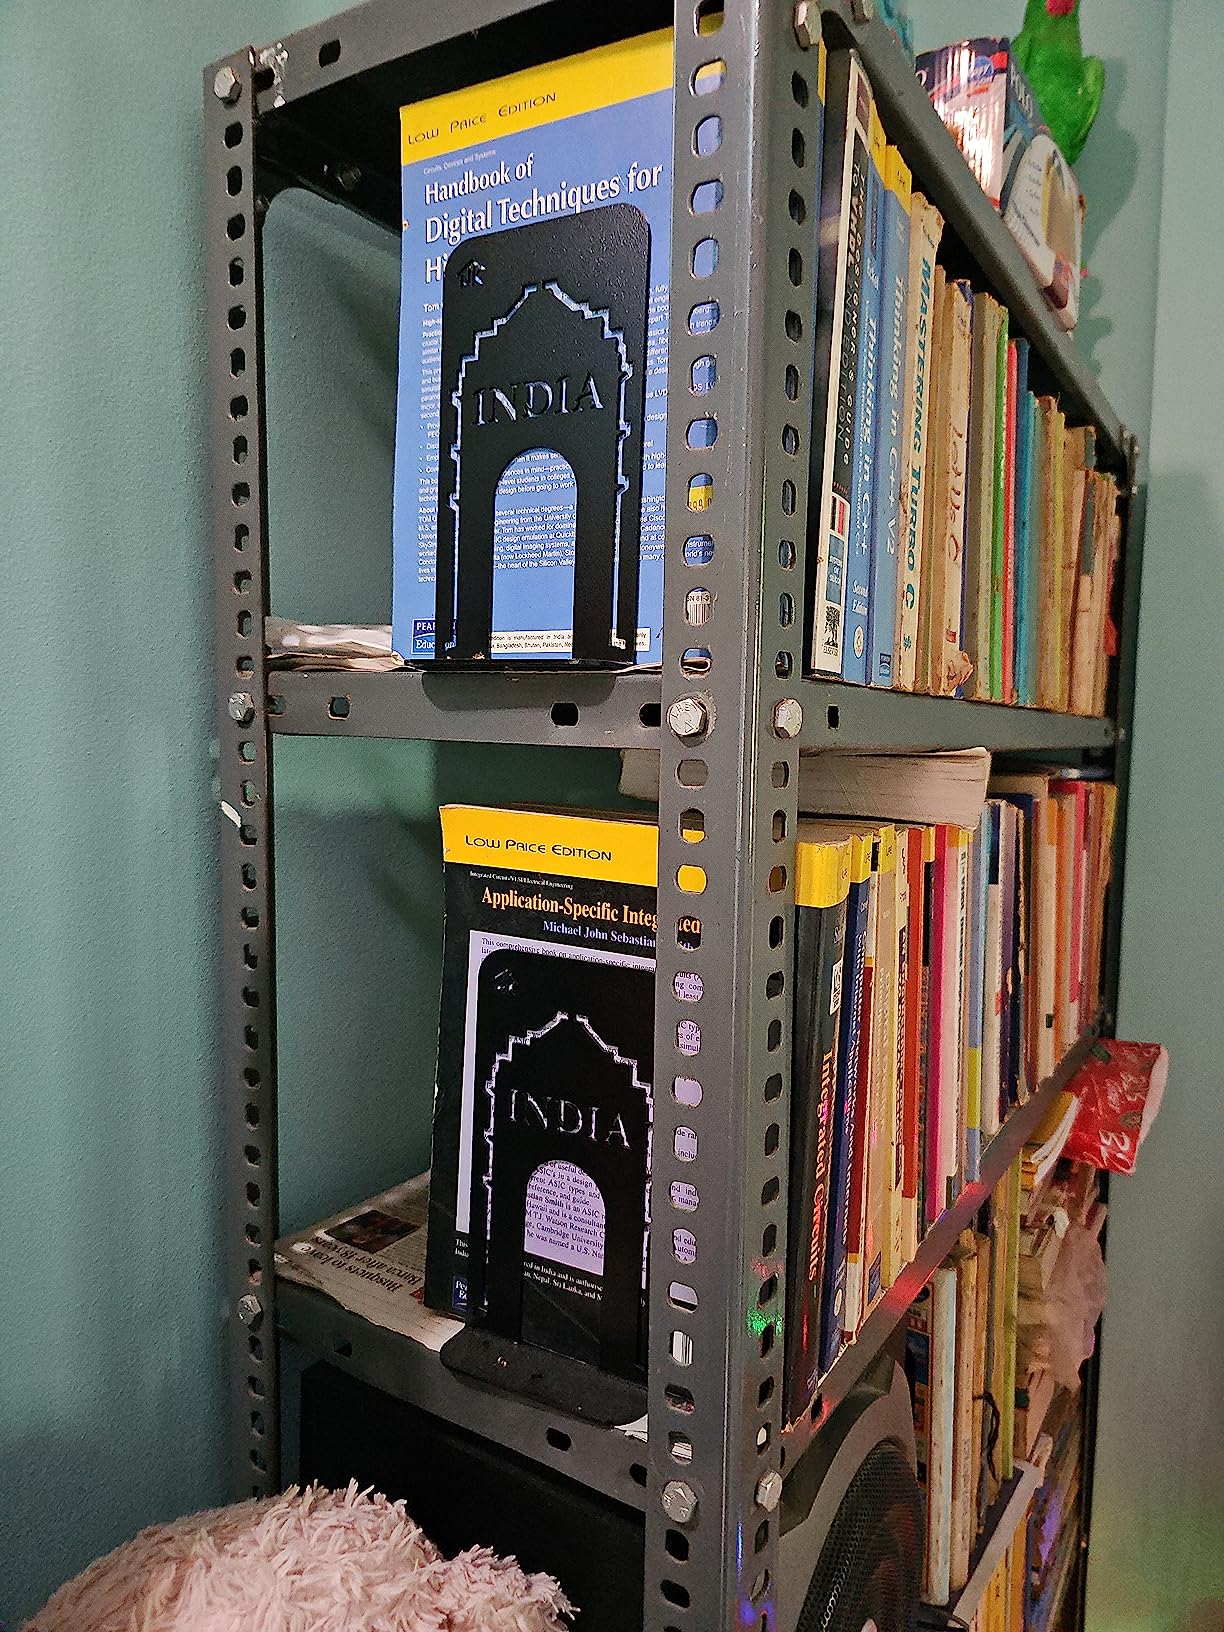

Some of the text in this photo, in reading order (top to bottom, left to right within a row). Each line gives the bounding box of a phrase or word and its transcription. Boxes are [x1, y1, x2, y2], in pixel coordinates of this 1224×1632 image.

[408, 92, 557, 145] LOW PRICE EDITION
[425, 153, 534, 205] Handbook of
[425, 162, 663, 246] Digital Techniques for
[472, 370, 604, 427] INDIA
[906, 257, 931, 610] MASTERING TURBO C
[888, 447, 898, 508] C++
[465, 834, 613, 862] LOW PRICE EDITION
[481, 886, 618, 922] Application-Specific
[481, 938, 495, 946] This
[543, 920, 582, 936] Michael
[584, 926, 608, 941] John
[509, 1088, 631, 1150] INDIA
[809, 1051, 833, 1282] Integrated Circuits
[548, 1179, 566, 1189] ASIC
[589, 1191, 600, 1199] and
[560, 1192, 571, 1201] and
[572, 1177, 593, 1188] design
[526, 1200, 548, 1212] Hawaii
[549, 1207, 560, 1216] and
[544, 1196, 564, 1207] Smith
[582, 1208, 600, 1218] ASIC
[536, 1222, 603, 1250] Cambridge University
[546, 1215, 598, 1237] Watson Research
[536, 1234, 547, 1242] was
[549, 1237, 569, 1249] named
[541, 1265, 556, 1276] India
[557, 1273, 569, 1281] and
